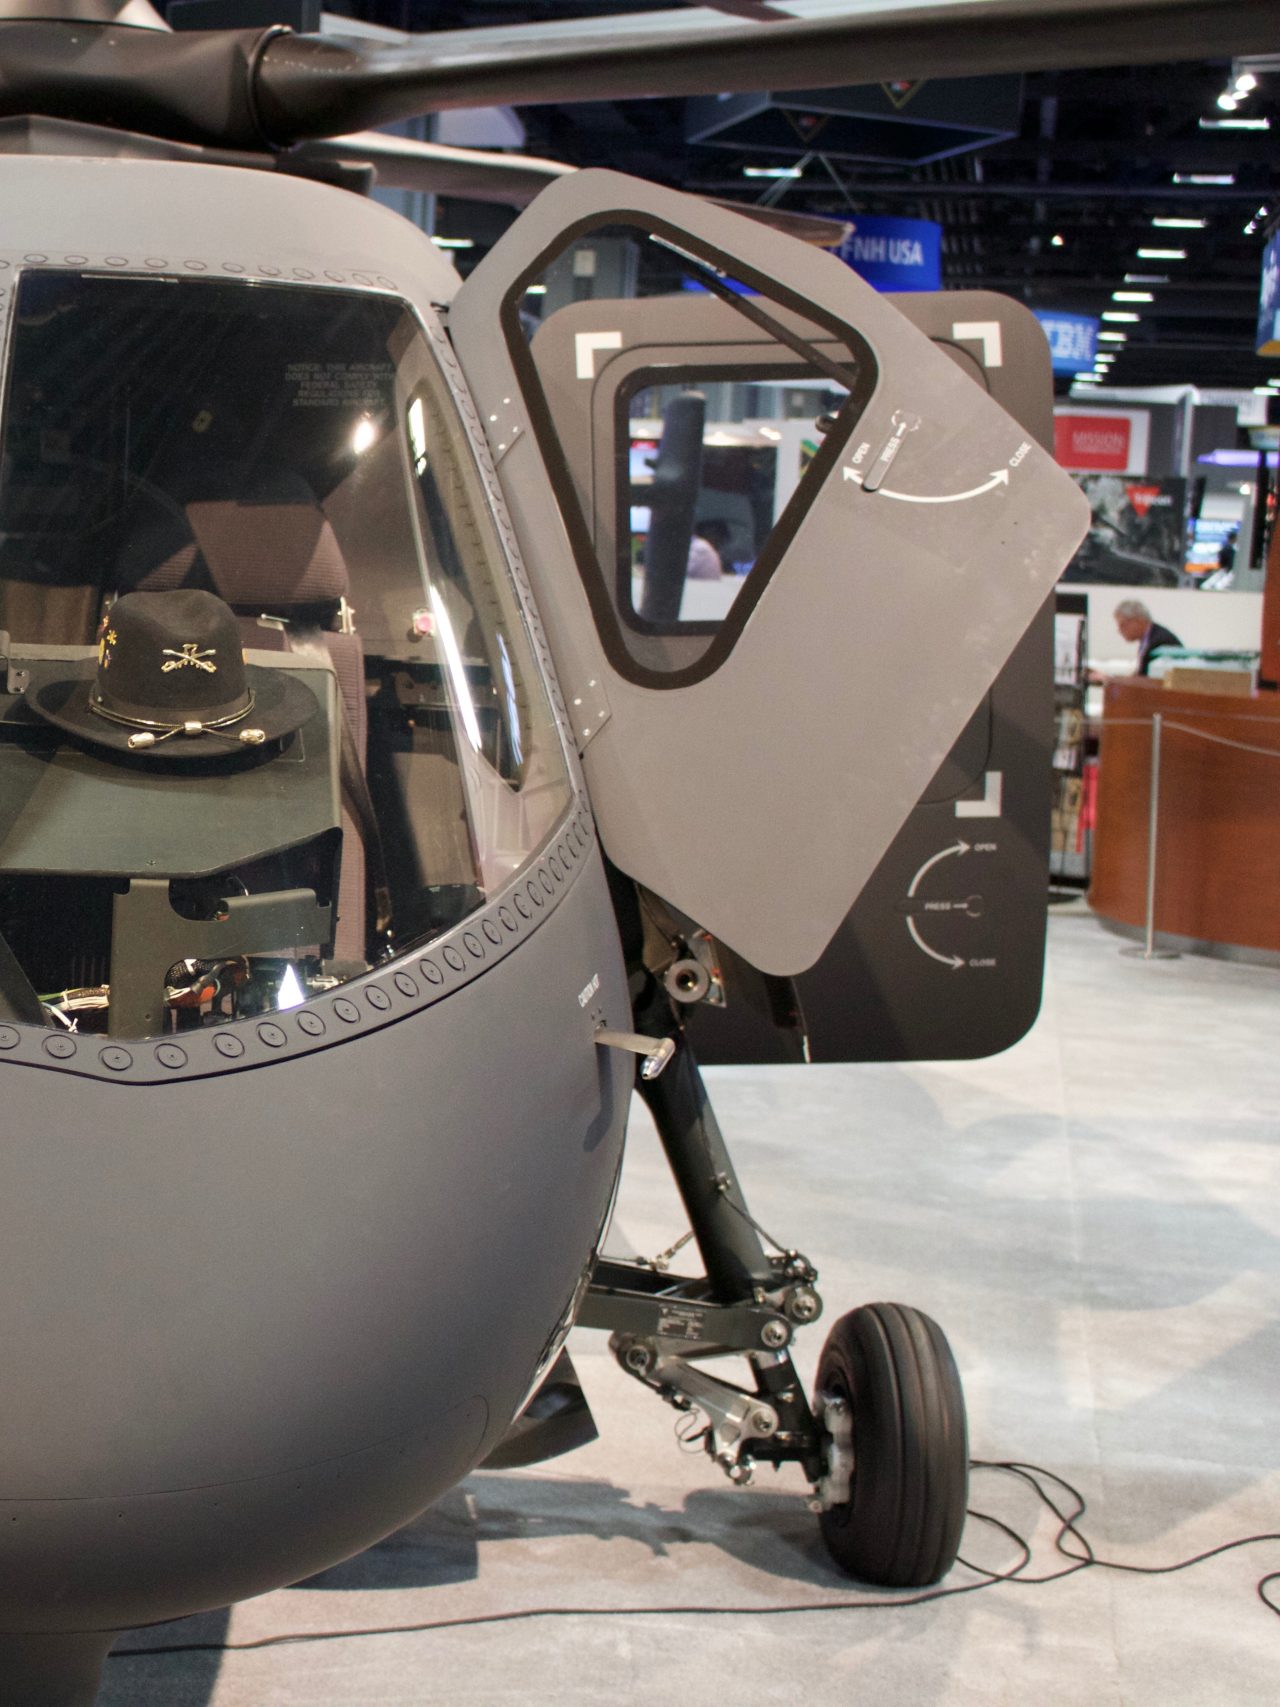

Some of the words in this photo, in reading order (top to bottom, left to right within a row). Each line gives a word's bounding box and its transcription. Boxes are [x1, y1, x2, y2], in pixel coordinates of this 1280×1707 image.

[888, 239, 924, 266] USA
[851, 441, 871, 464] OPEN
[880, 437, 901, 463] PRESS
[1009, 441, 1032, 467] CLOSE
[974, 843, 997, 851] OPEN
[924, 902, 951, 910] PRESS
[969, 959, 996, 967] CLOSE
